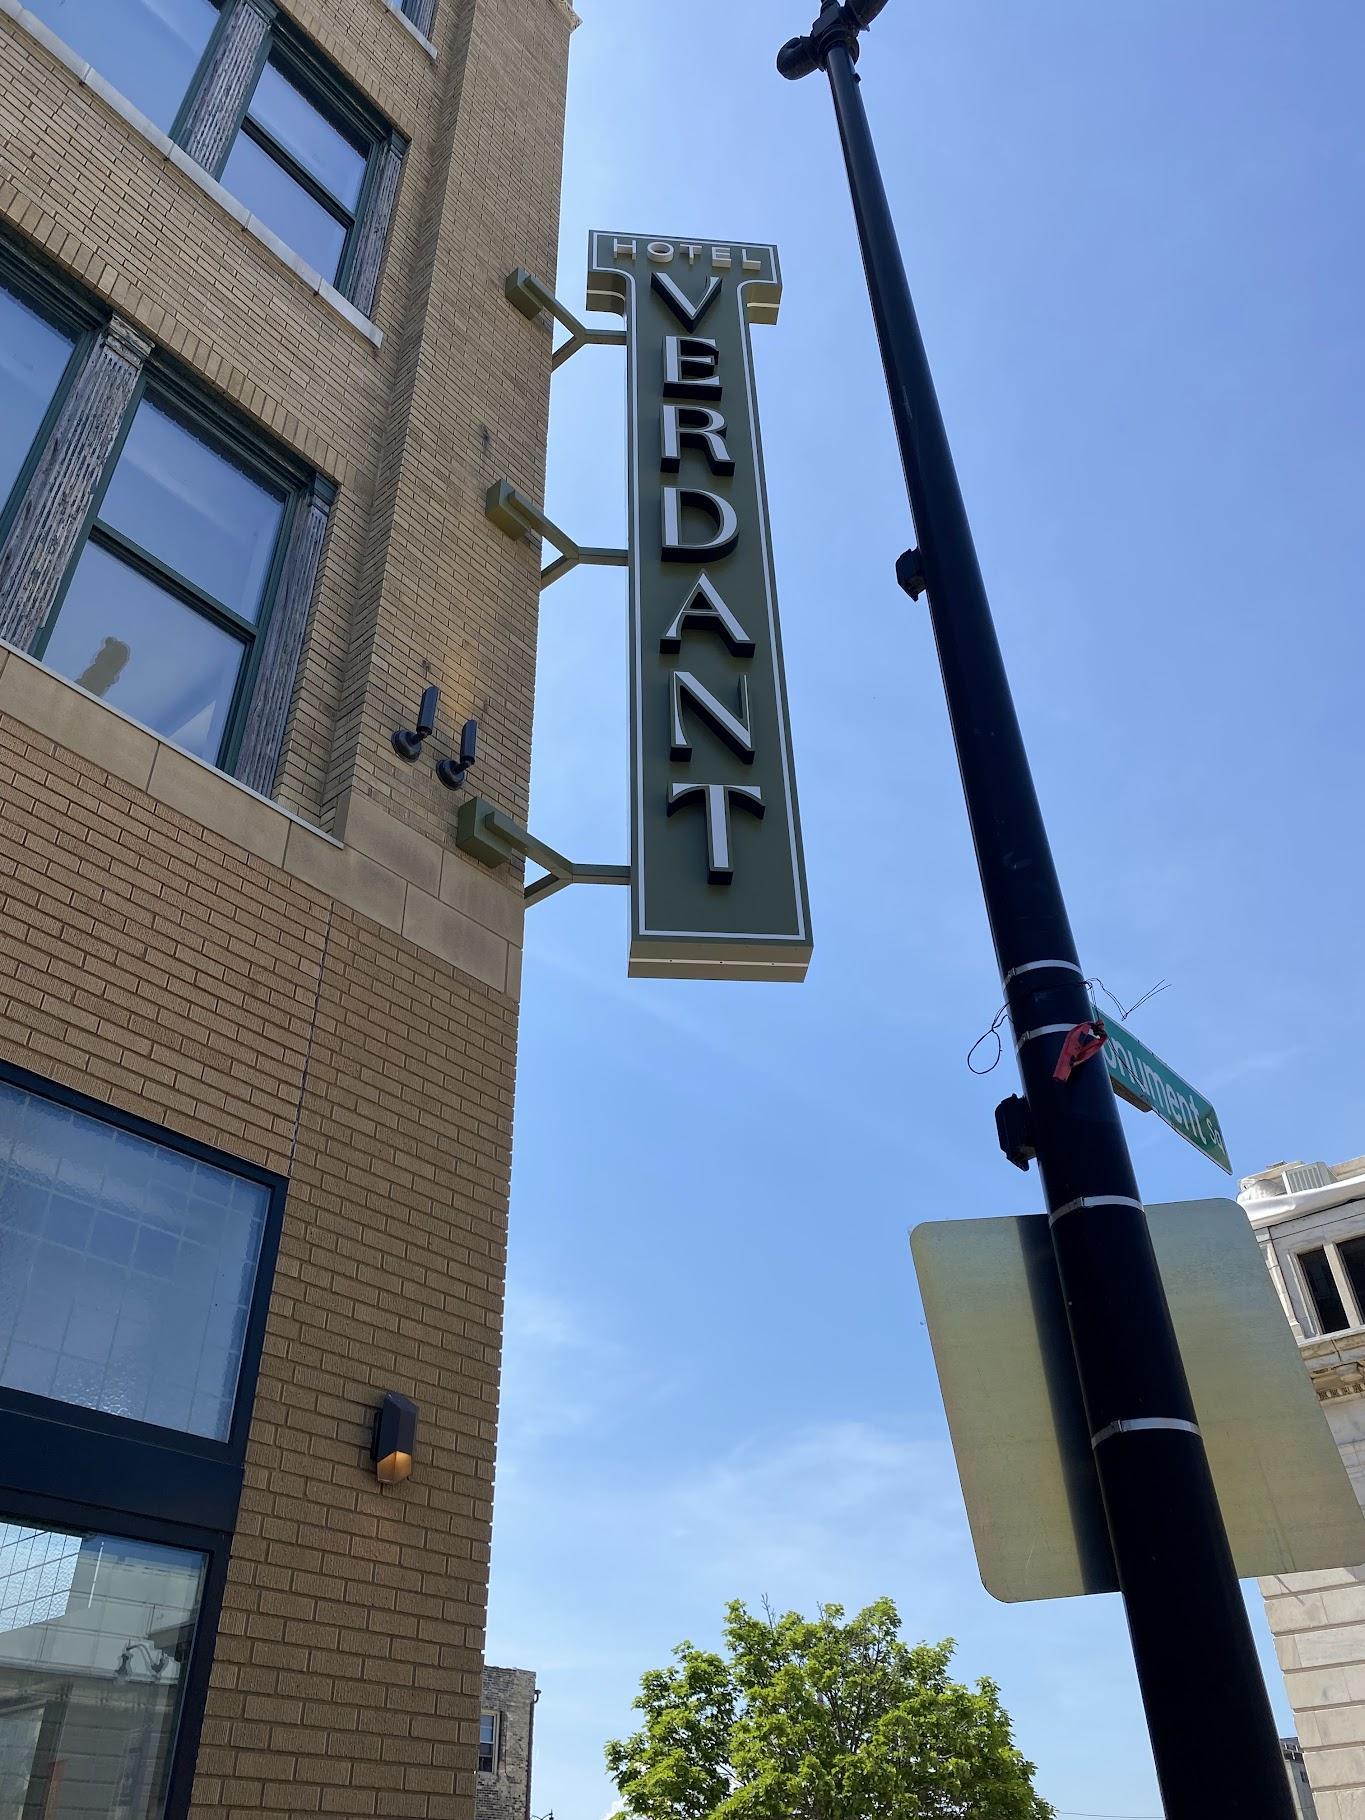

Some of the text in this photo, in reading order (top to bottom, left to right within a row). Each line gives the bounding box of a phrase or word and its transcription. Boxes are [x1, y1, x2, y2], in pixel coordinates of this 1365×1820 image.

[612, 238, 761, 270] HOTEL
[650, 271, 766, 885] VERDANT
[1101, 1037, 1207, 1145] onument
